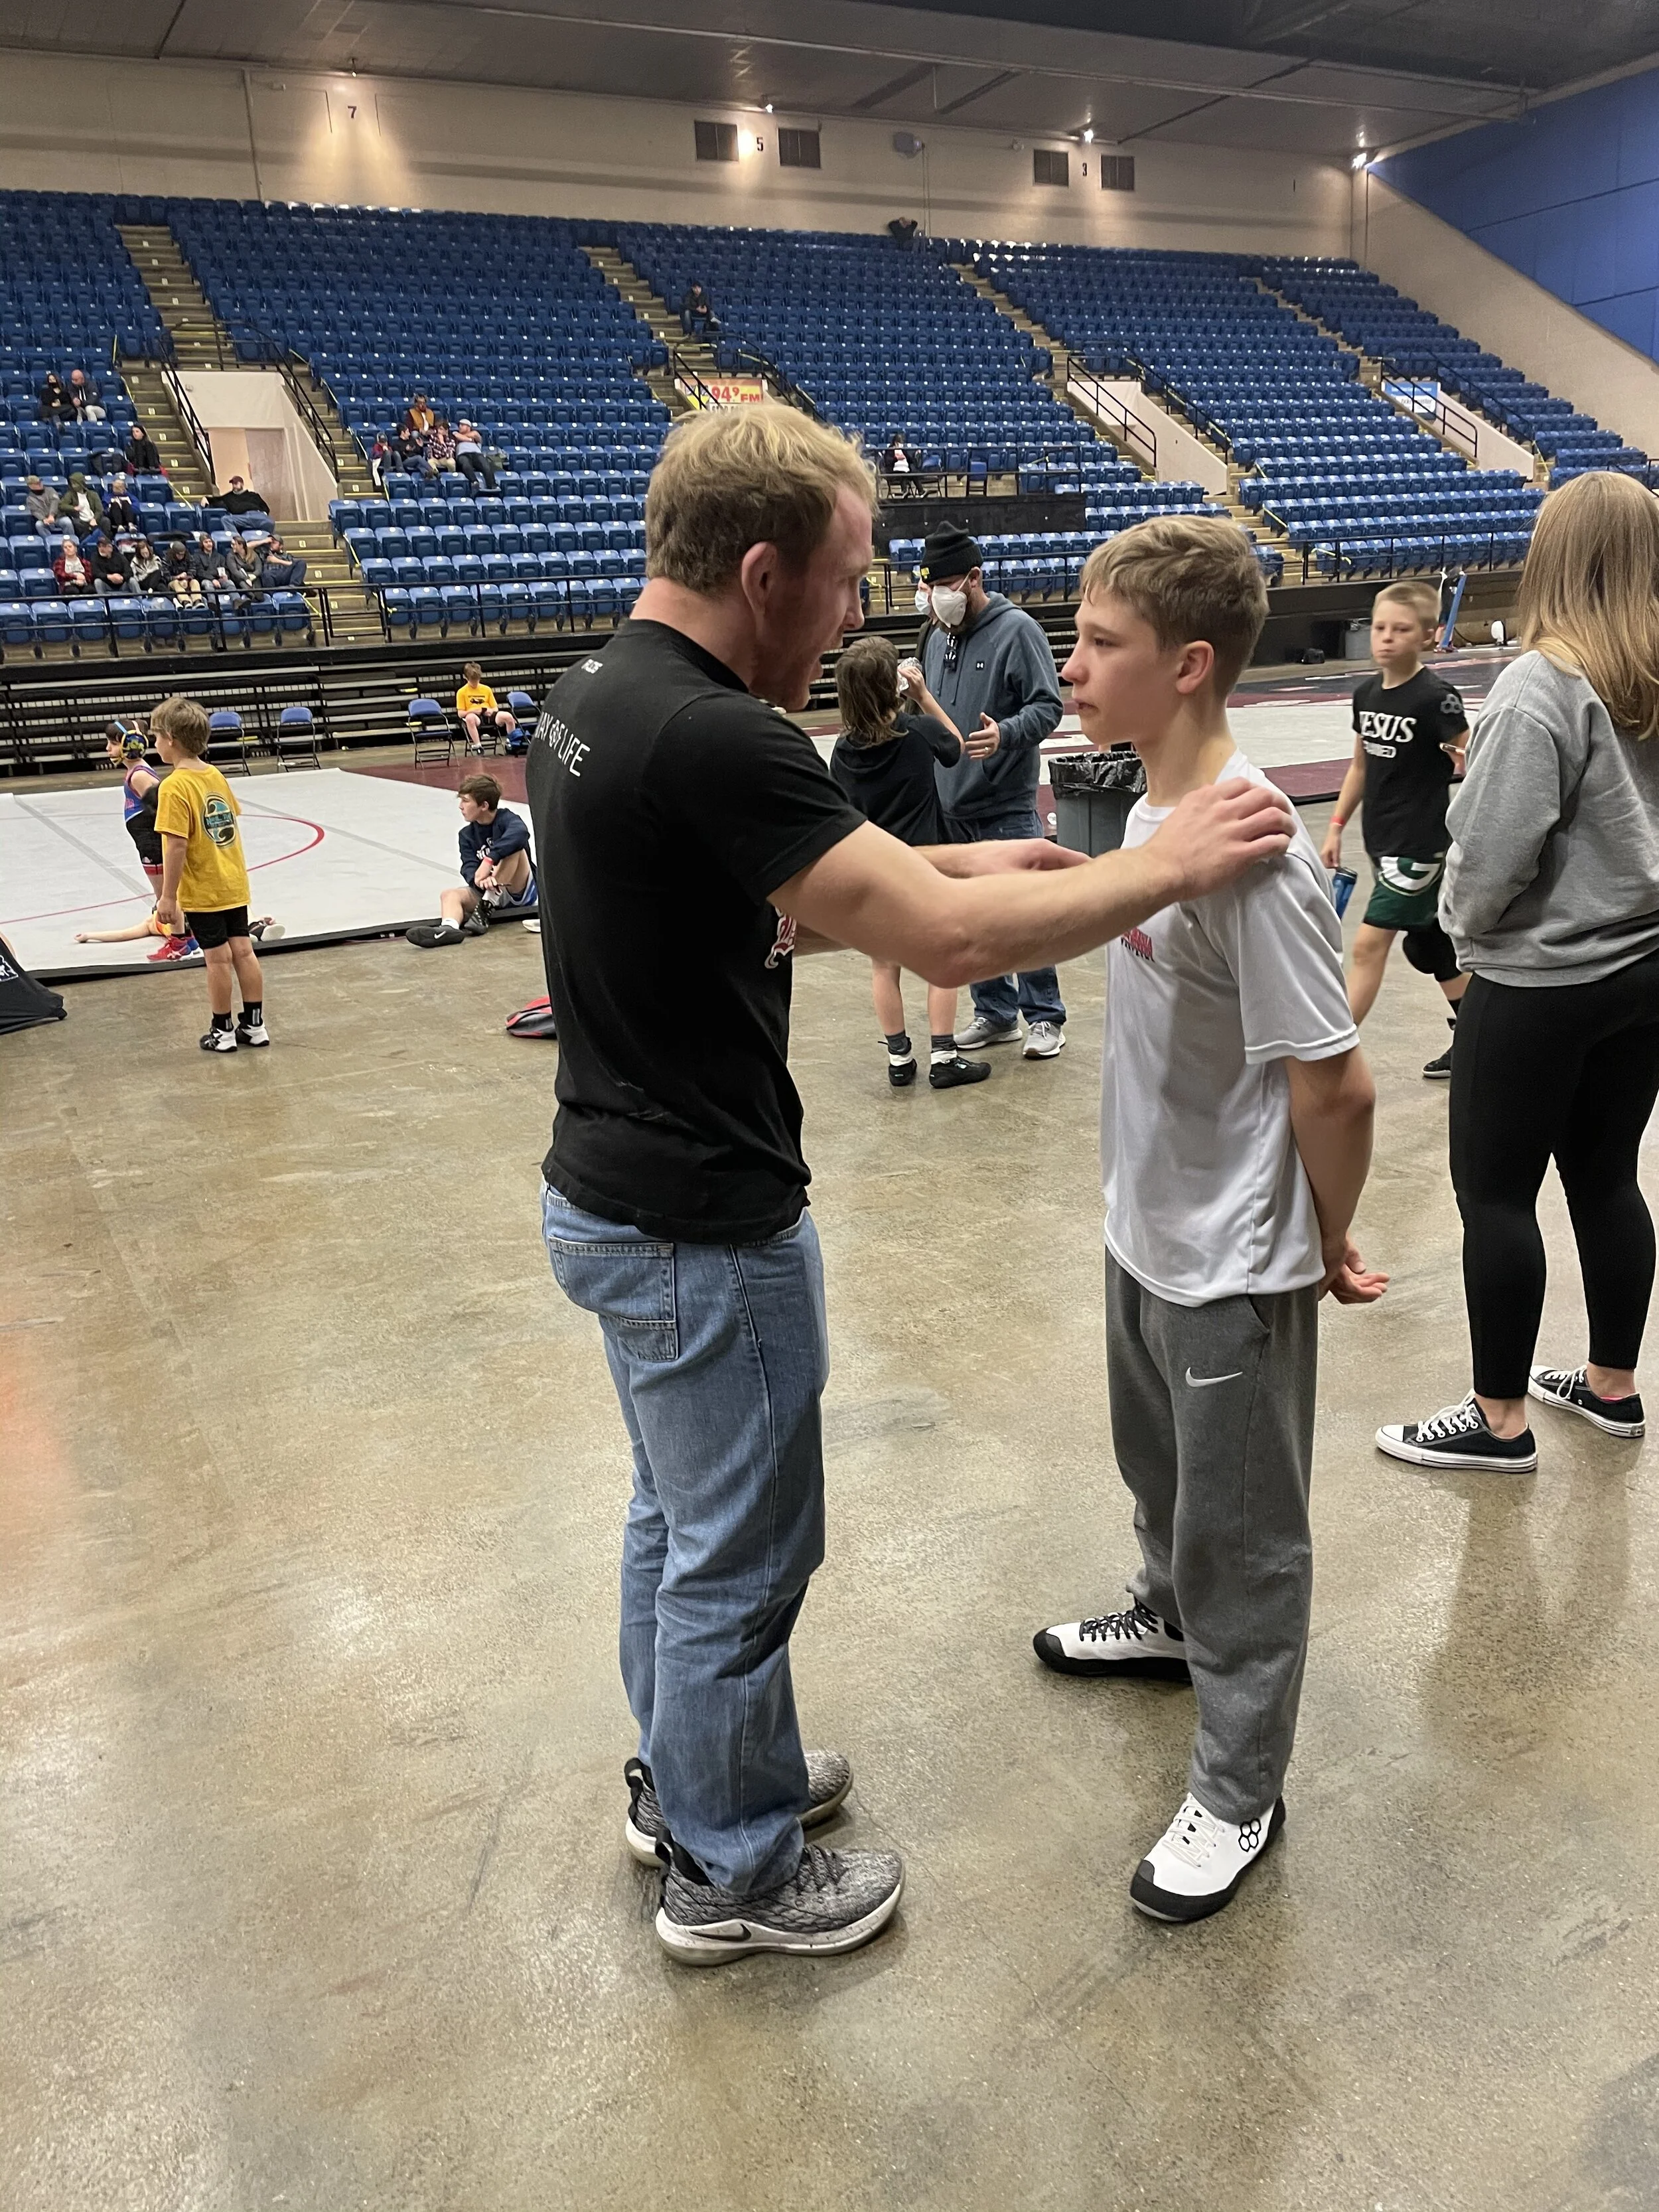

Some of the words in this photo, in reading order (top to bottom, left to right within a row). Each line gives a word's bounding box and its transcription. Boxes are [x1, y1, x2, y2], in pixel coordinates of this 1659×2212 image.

[347, 106, 357, 118] 7
[756, 137, 764, 151] 5
[1082, 163, 1088, 177] 3
[740, 394, 760, 403] FM
[1359, 711, 1417, 743] ESUS
[557, 728, 591, 777] LIFE
